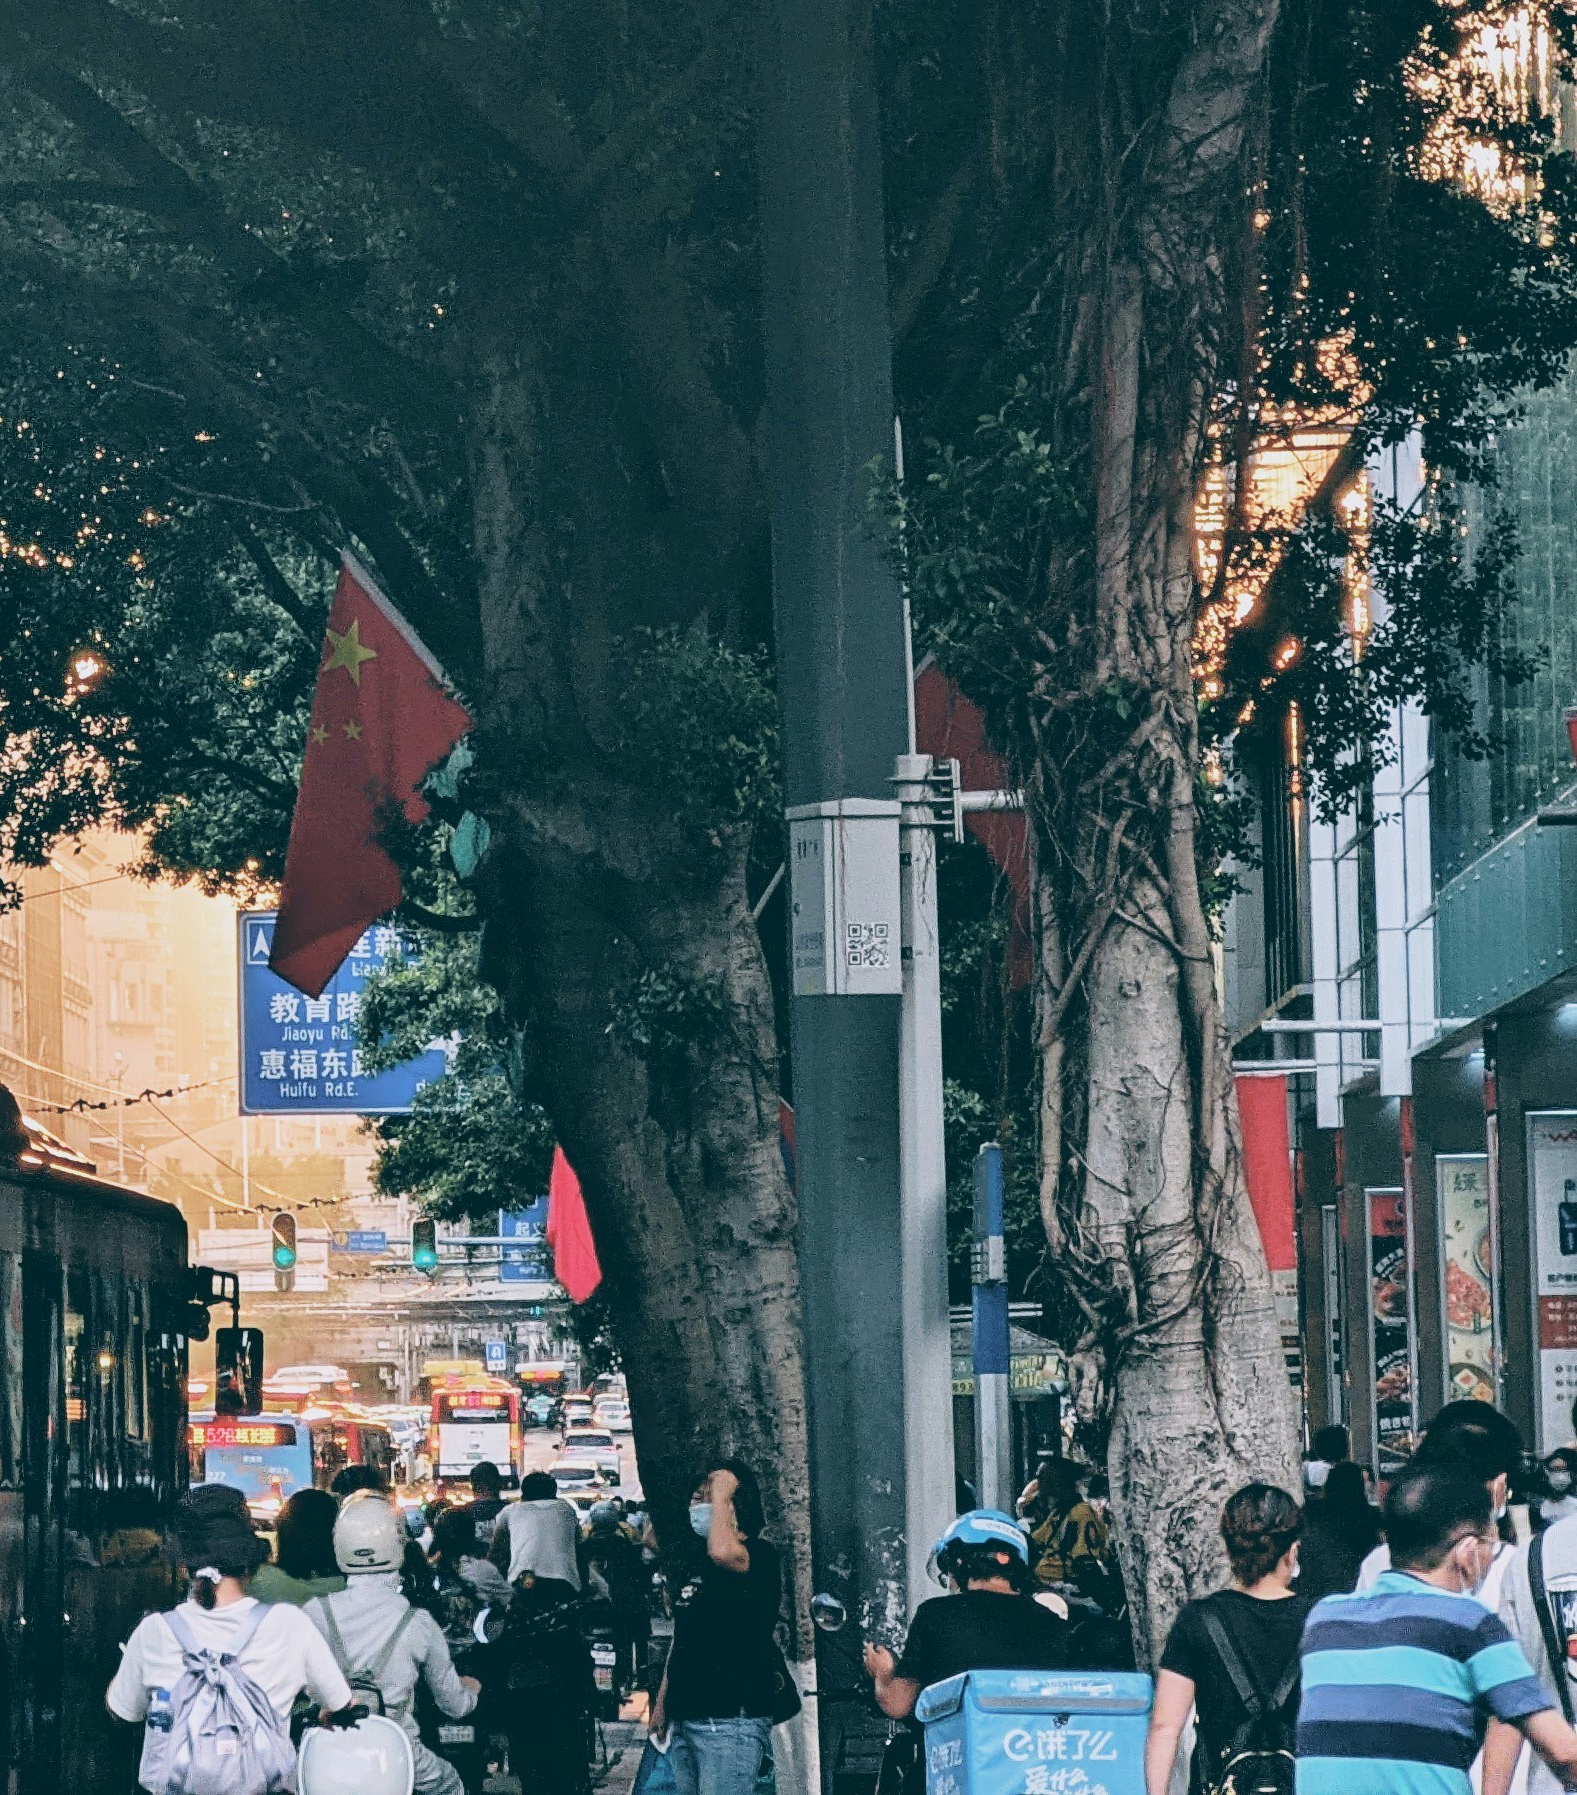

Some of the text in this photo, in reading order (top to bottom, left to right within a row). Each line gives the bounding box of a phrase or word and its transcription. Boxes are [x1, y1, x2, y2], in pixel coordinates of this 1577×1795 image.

[282, 1024, 353, 1045] Jiaoyu Rd.
[280, 1081, 317, 1098] Huifu
